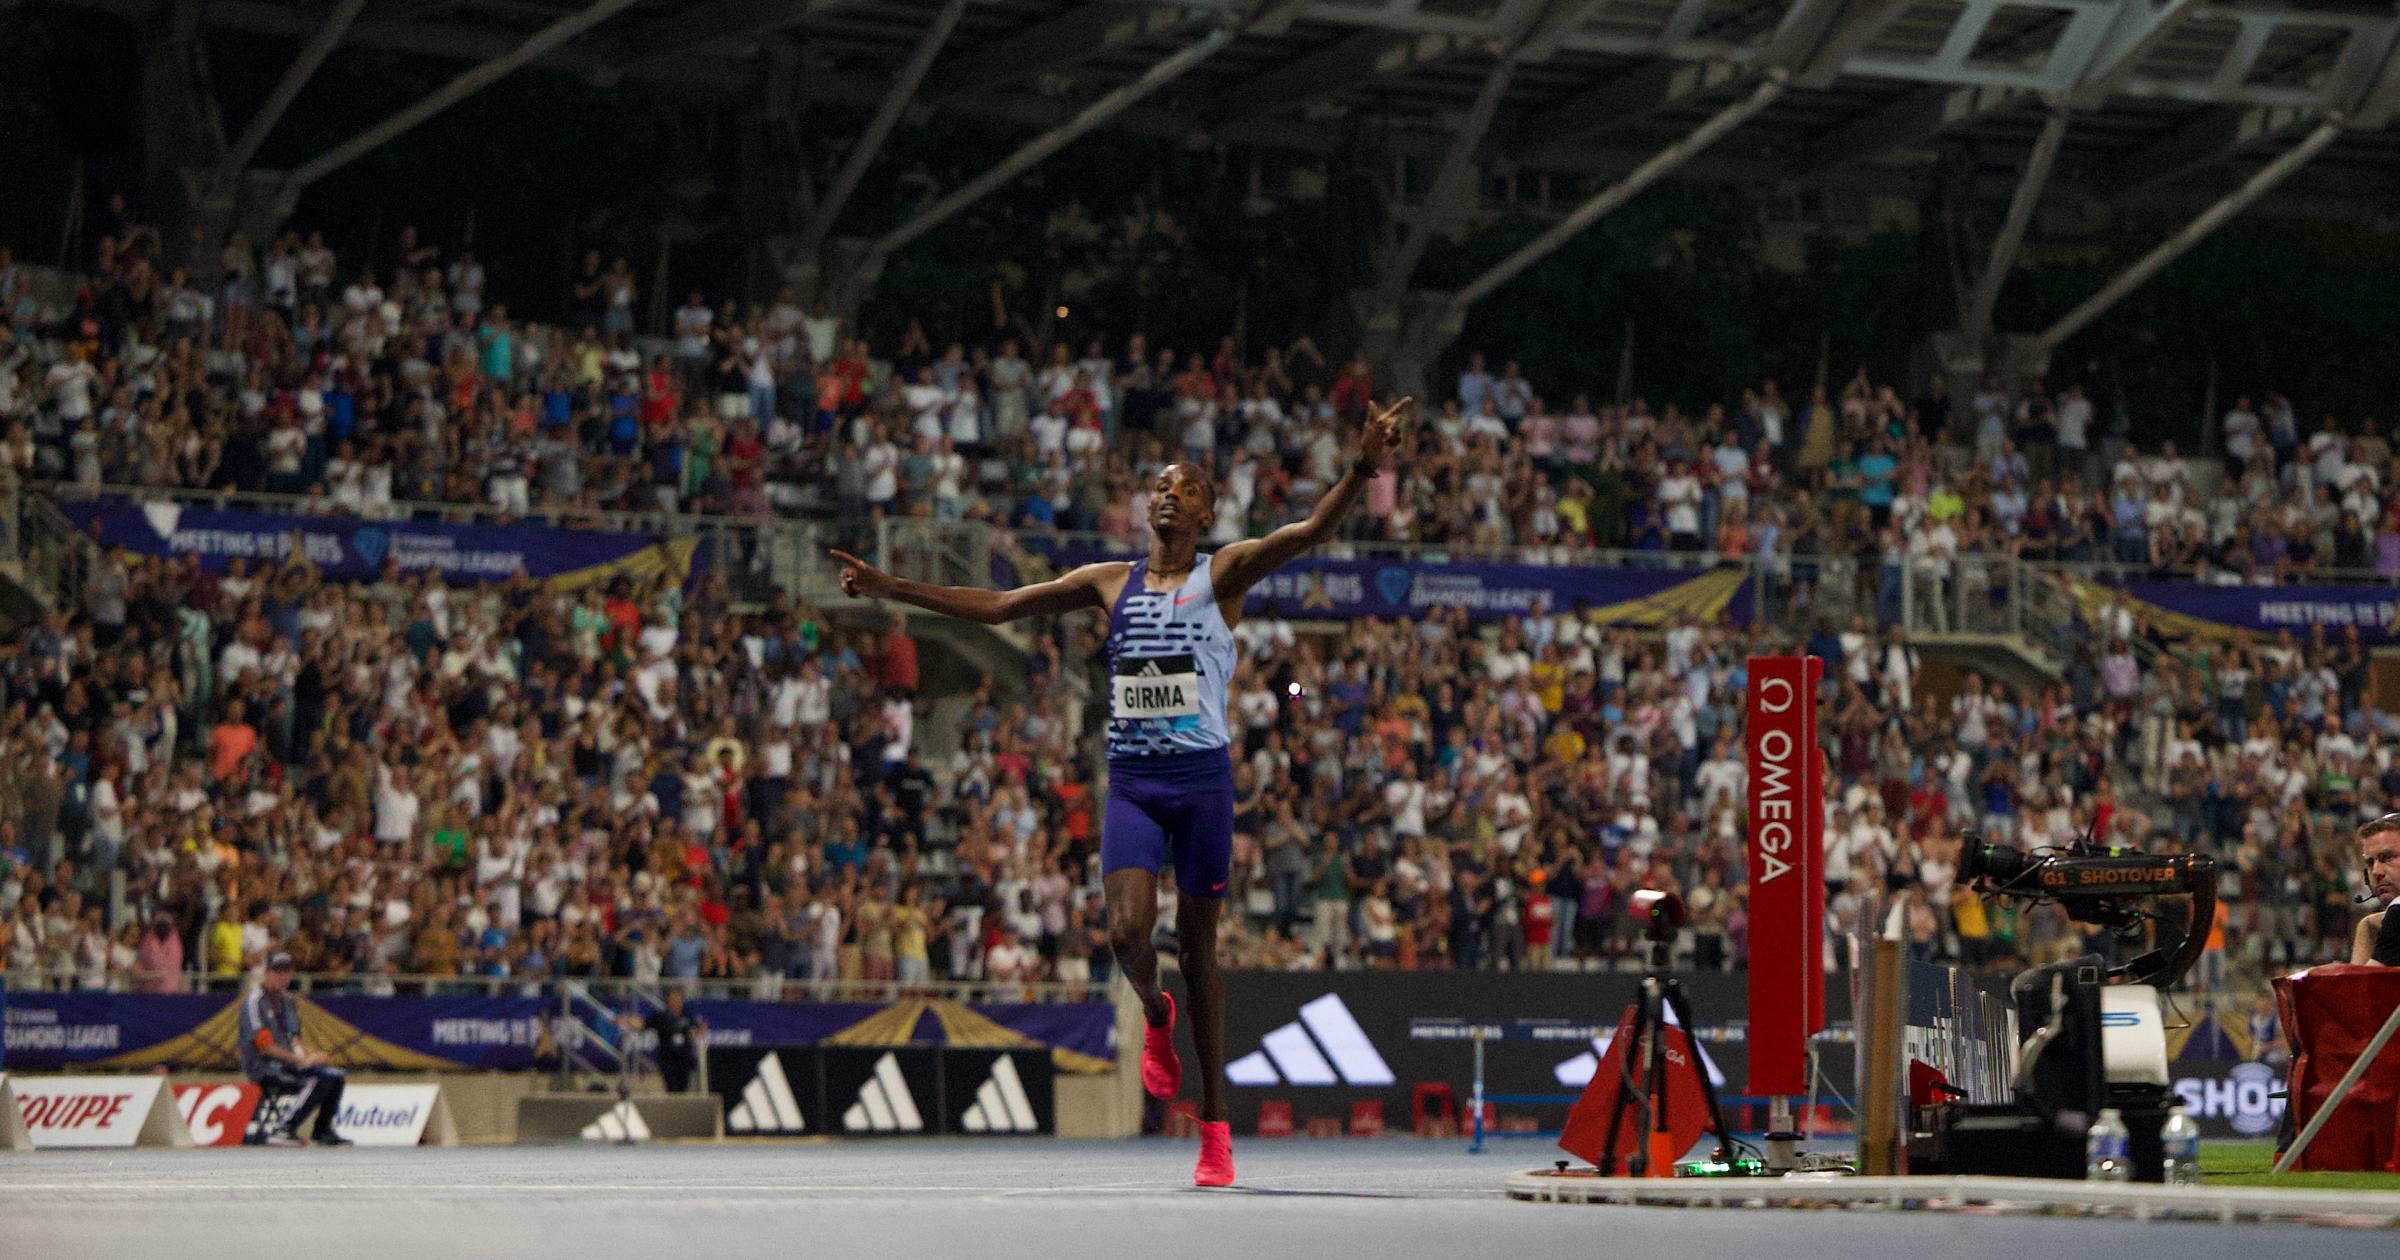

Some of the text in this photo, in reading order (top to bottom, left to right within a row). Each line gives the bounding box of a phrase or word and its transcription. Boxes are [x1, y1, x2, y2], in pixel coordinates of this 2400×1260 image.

[1124, 684, 1186, 709] GIRMA
[1759, 729, 1793, 884] OMEGA
[2043, 867, 2176, 886] G1 SHOTOVER
[433, 1018, 509, 1045] MEETING
[16, 1093, 133, 1129] QUIPE
[336, 1104, 418, 1128] Mutuel
